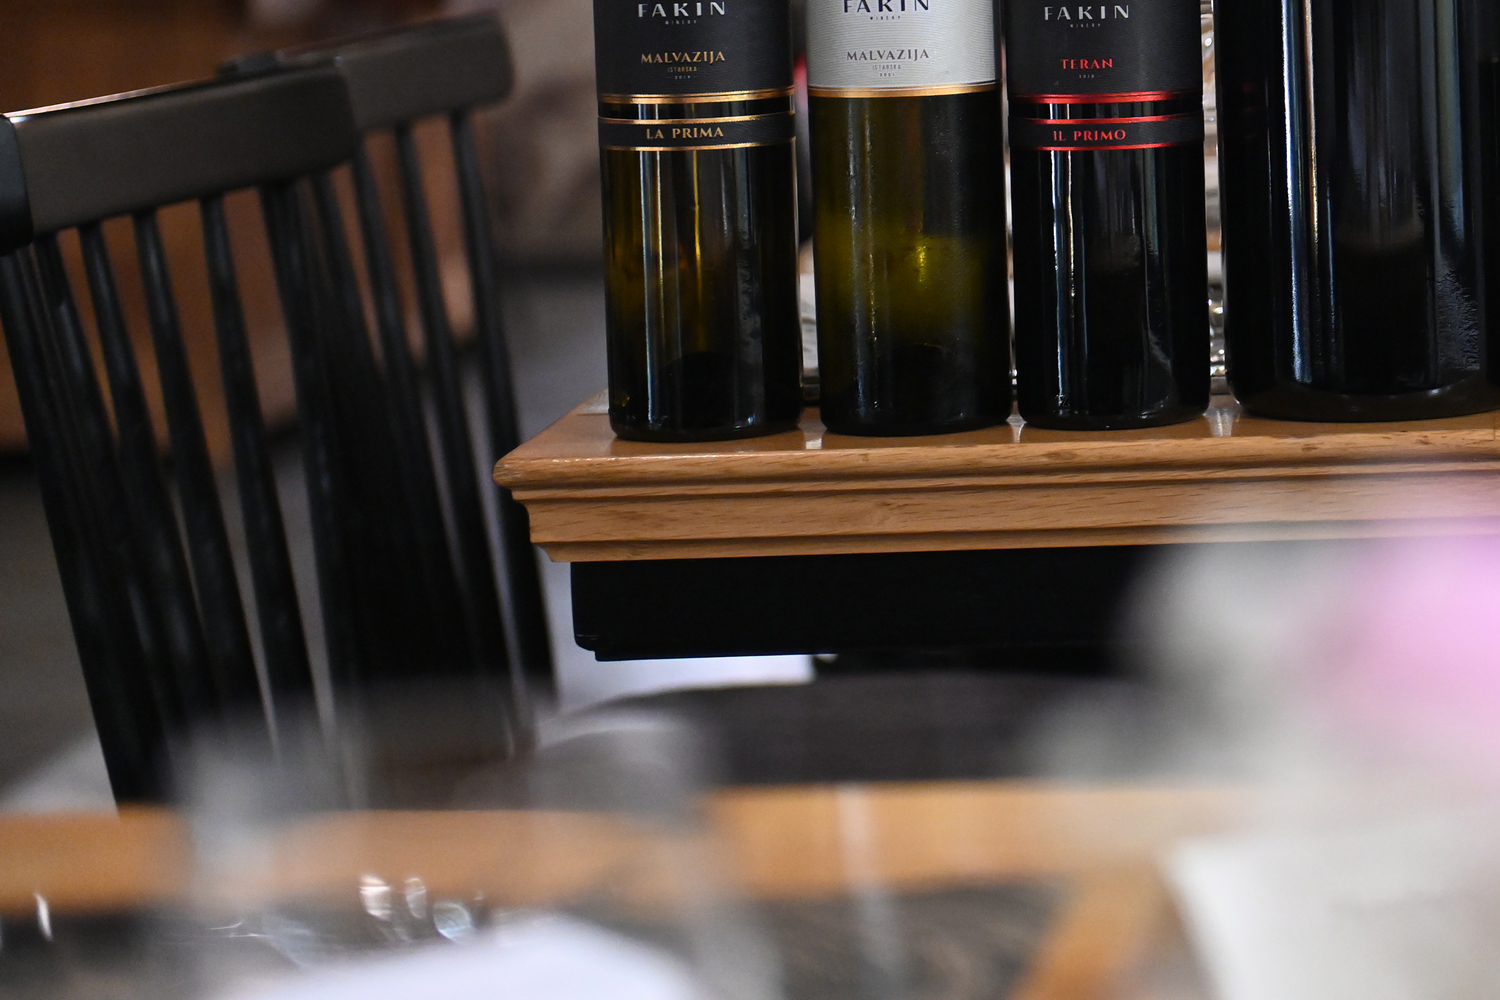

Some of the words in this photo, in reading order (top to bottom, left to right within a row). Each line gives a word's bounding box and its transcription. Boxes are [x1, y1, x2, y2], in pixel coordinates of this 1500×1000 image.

[637, 1, 726, 18] FAKIN
[1044, 5, 1129, 20] FAKIN
[640, 50, 726, 65] MALVAZIJA
[846, 49, 930, 62] MALVAZIJA
[1060, 58, 1113, 69] TERAN
[646, 128, 664, 140] LA
[672, 126, 724, 139] PRIMA
[1053, 130, 1067, 141] IL
[1074, 129, 1127, 141] PRIMO
